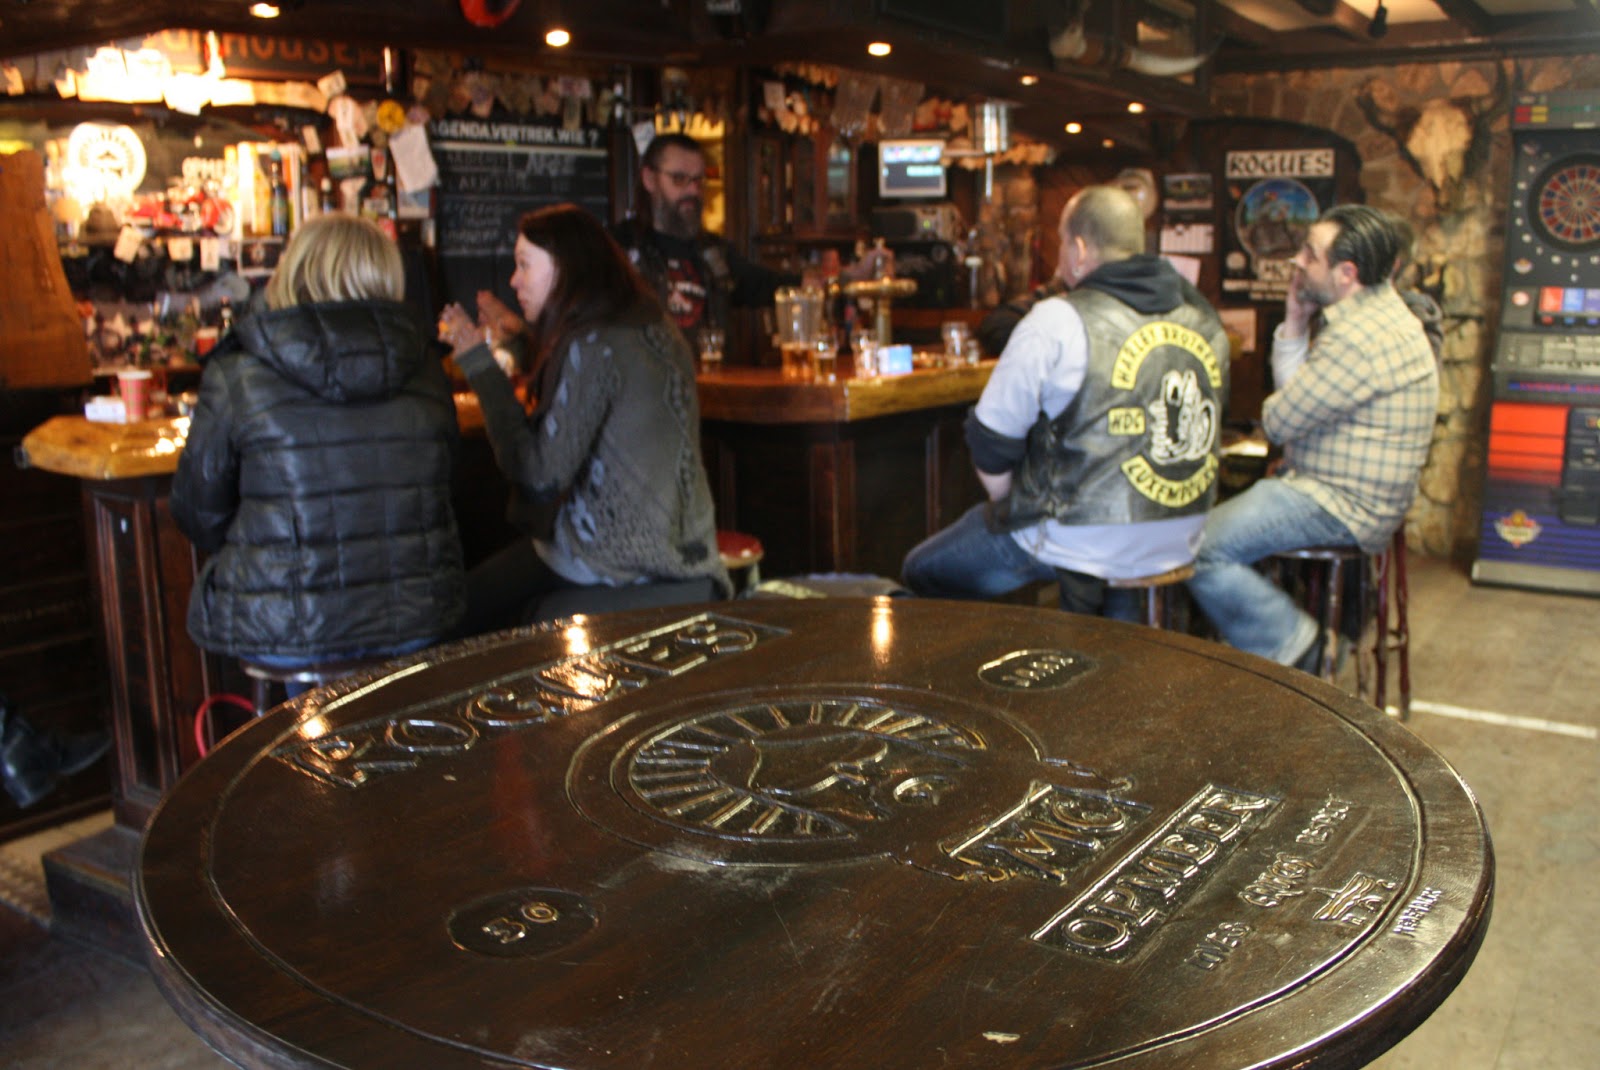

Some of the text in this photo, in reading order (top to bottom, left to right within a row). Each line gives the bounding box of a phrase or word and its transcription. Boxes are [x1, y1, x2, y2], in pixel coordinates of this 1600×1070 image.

[1230, 152, 1331, 174] ROGUES
[1114, 324, 1159, 384] HARLEY
[300, 618, 758, 787] ROGUES
[986, 796, 1127, 886] MC
[1061, 792, 1269, 952] OPMEER
